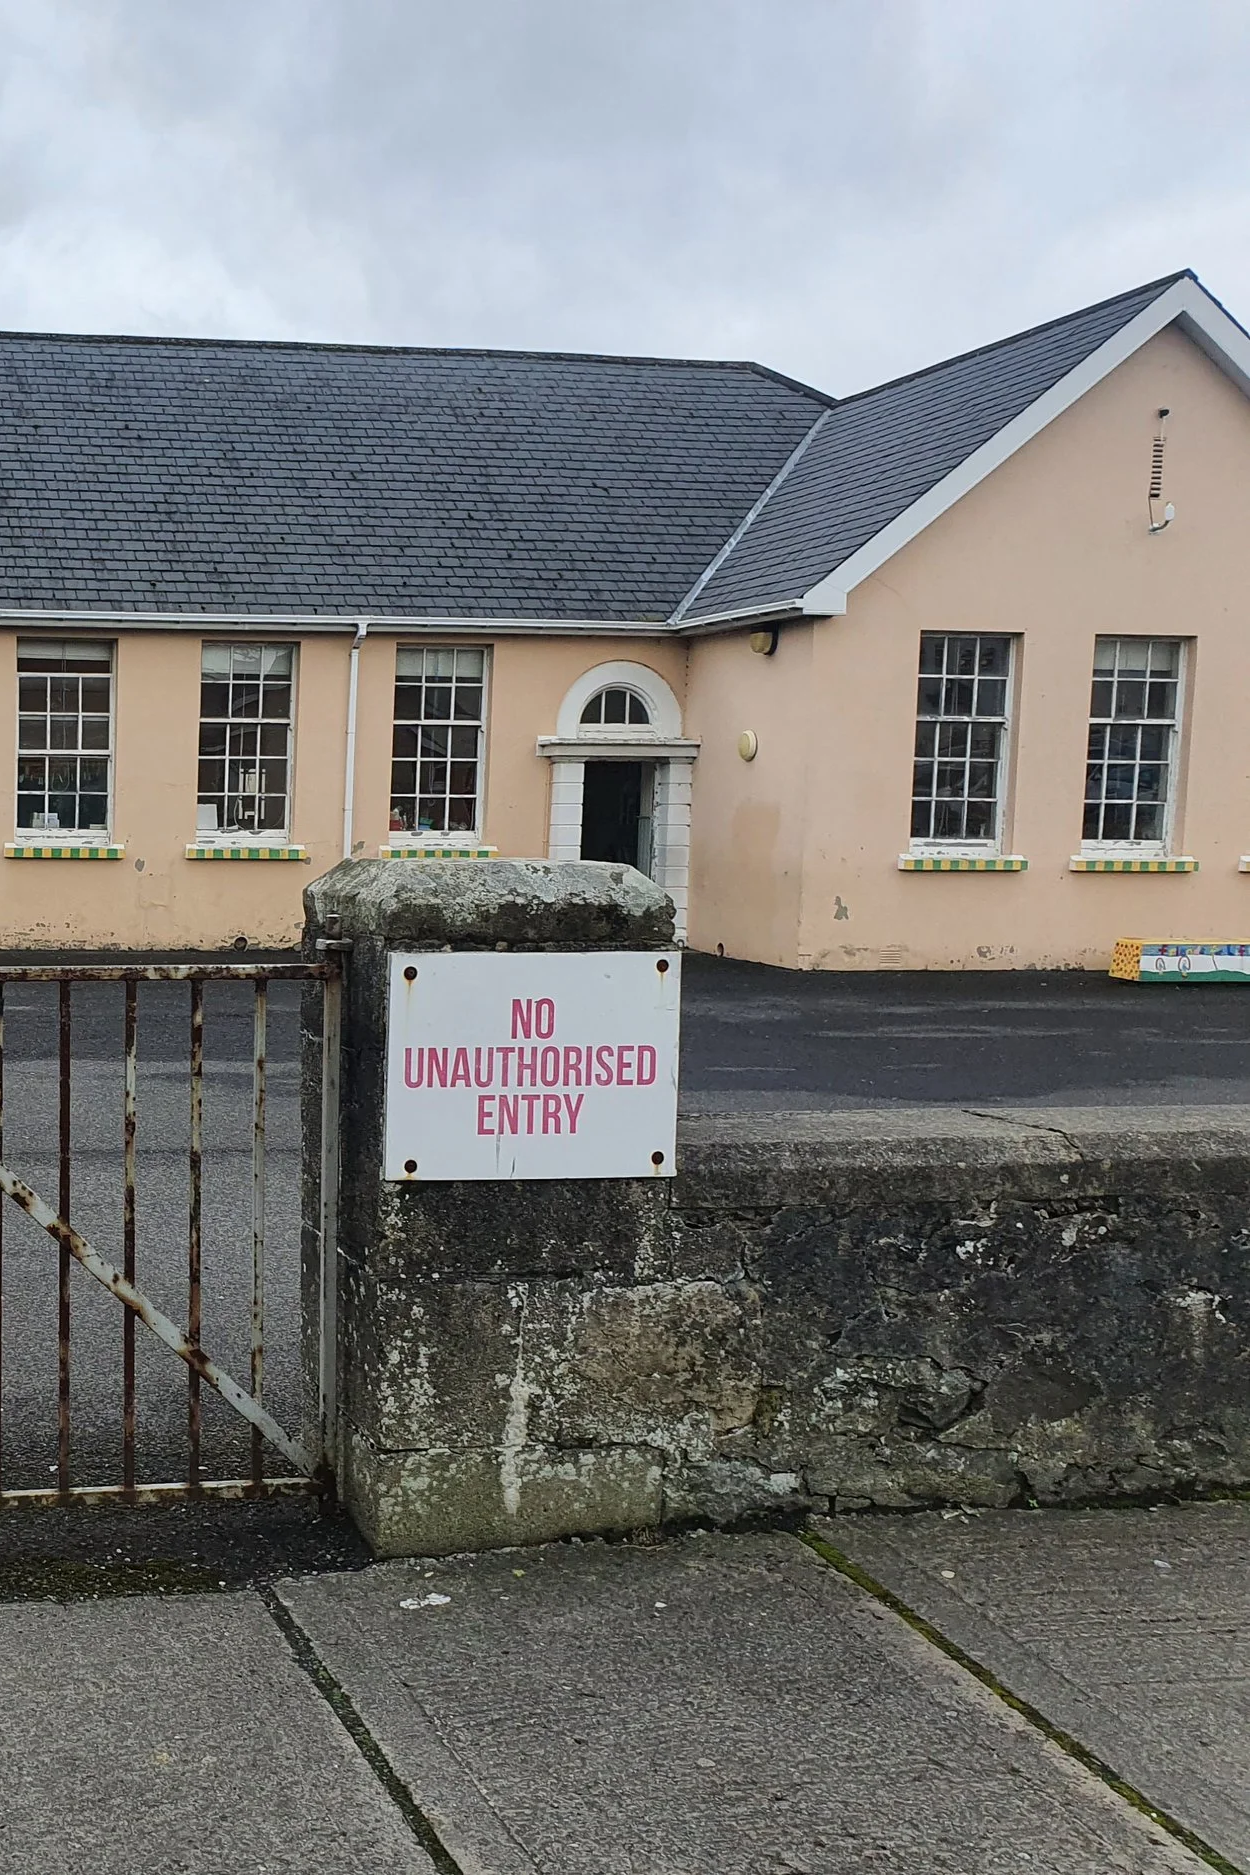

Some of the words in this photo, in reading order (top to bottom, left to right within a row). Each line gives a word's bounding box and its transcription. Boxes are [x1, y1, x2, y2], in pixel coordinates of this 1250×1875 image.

[510, 998, 555, 1040] NO
[404, 1045, 657, 1088] UNAUTHORISED
[476, 1093, 585, 1136] ENTRY
